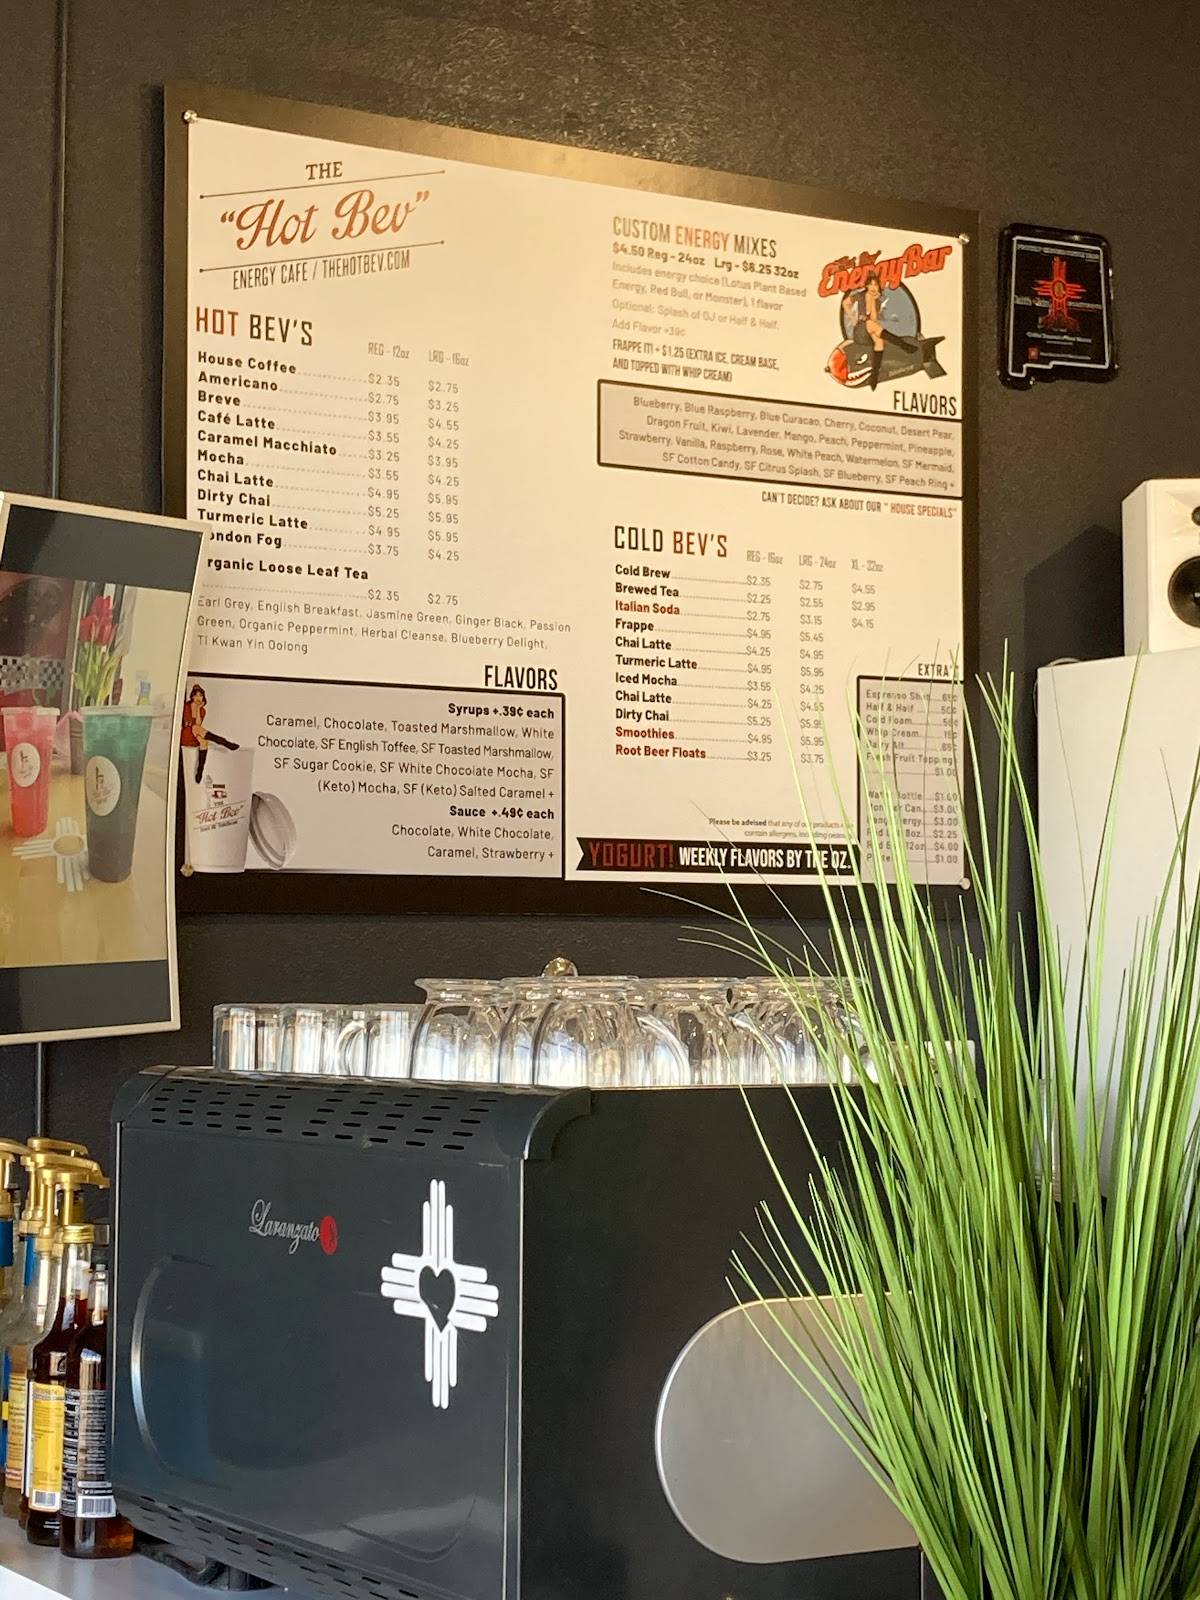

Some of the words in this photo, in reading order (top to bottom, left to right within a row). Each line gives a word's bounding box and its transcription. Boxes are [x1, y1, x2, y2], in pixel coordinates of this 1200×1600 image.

[306, 162, 342, 180] THE
[613, 216, 670, 243] CUSTOM
[676, 226, 730, 252] ENERGY
[734, 234, 777, 258] MIXES
[233, 266, 275, 290] ENERGY
[281, 261, 308, 284] CAFE
[322, 249, 410, 280] THEHOTBEV.COM
[648, 248, 667, 262] Reg
[678, 252, 705, 266] 24oz
[715, 258, 732, 272] Lrg
[774, 265, 799, 279] 32oz
[196, 306, 239, 337] HOT
[249, 314, 312, 346] BEV'S
[613, 339, 642, 354] FRAPPE
[731, 353, 756, 368] CREAM
[198, 351, 242, 367] House
[248, 358, 296, 374] Coffee
[368, 373, 400, 386] $2.35
[428, 380, 458, 394] $2.75
[613, 357, 628, 369] AND
[632, 359, 659, 373] TOPPED
[661, 363, 680, 376] WITH
[682, 366, 702, 378] WHIP
[198, 371, 278, 391] Americano
[368, 392, 399, 405] $2.75
[428, 399, 459, 412] $3.25
[198, 390, 240, 406] Breve
[368, 411, 399, 424] $3.95
[894, 391, 957, 416] FLAVORS
[198, 410, 231, 424] Café
[236, 415, 275, 429] Latte
[368, 430, 399, 443] $3.55
[428, 436, 459, 450] $4.25
[647, 416, 681, 429] Dragon
[198, 430, 257, 447] Caramel
[264, 436, 336, 455] Macchiato
[368, 449, 400, 462] $3.25
[198, 449, 244, 465] Mocha
[662, 452, 674, 462] SF
[677, 454, 709, 466] Cotton
[198, 469, 229, 483] Chai
[235, 473, 273, 487] Latte
[198, 489, 234, 505] Dirty
[239, 493, 270, 506] Chai
[368, 506, 399, 519] $5.25
[762, 491, 785, 503] CAN'T
[788, 494, 819, 506] DECIDE?
[822, 496, 836, 508] ASK
[839, 498, 864, 510] ABOUT
[866, 500, 881, 511] OUR
[198, 508, 264, 525] Turmeric
[270, 515, 308, 529] Latte
[257, 534, 282, 548] Fog
[368, 544, 399, 556] $3.75
[428, 548, 459, 561] $4.25
[615, 526, 663, 552] COLD
[674, 530, 727, 558] BEV'S
[208, 558, 254, 571] rganic
[259, 560, 303, 575] Loose
[308, 564, 339, 577] Leaf
[345, 567, 368, 580] Tea
[616, 564, 639, 576] Cold
[643, 566, 670, 578] Brew
[616, 582, 657, 595] Brewed
[660, 586, 679, 597] Tea
[616, 600, 649, 612] Italian
[653, 603, 680, 615] Soda
[197, 616, 235, 629] Green,
[239, 618, 284, 632] Organic
[288, 622, 358, 637] Peppermint,
[361, 626, 398, 640] Herbal
[401, 629, 446, 642] Cleanse,
[451, 633, 503, 648] Blueberry
[616, 618, 654, 632] Frappe
[212, 637, 242, 648] Kwan
[247, 638, 264, 649] Yin
[269, 640, 308, 654] Oolong
[616, 636, 639, 648] Chai
[642, 638, 671, 650] Latte
[616, 655, 665, 668] Turmeric
[669, 658, 697, 669] Latte
[918, 664, 959, 677] EXTRA
[484, 664, 558, 690] FLAVORS
[616, 672, 639, 683] Iced
[642, 674, 677, 686] Mocha
[616, 690, 639, 702] Chai
[642, 692, 672, 703] Latte
[448, 703, 489, 717] Syrups
[527, 708, 554, 719] each
[616, 708, 642, 722] Dirty
[645, 710, 669, 721] Chai
[266, 715, 319, 728] Caramel,
[324, 717, 387, 732] Chocolate,
[392, 720, 437, 733] Toasted
[441, 723, 518, 738] Marshmallow,
[522, 727, 554, 739] White
[616, 726, 674, 739] Smoothies
[616, 744, 641, 755] Root
[644, 746, 669, 757] Beer
[672, 747, 706, 758] Floats
[274, 758, 290, 768] SF
[293, 758, 328, 772] Sugar
[332, 760, 376, 772] Cookie,
[380, 762, 395, 772] SF
[399, 762, 432, 774] White
[436, 764, 493, 776] Chocolate
[497, 767, 536, 779] Mocha,
[450, 806, 486, 817] Sauce
[527, 809, 554, 819] each
[428, 846, 478, 858] Caramel,
[482, 848, 544, 862] Strawberry
[589, 842, 674, 868] YOGURT!
[679, 846, 728, 867] WEEKLY
[730, 848, 784, 868] FLAVORS
[786, 850, 802, 868] BY
